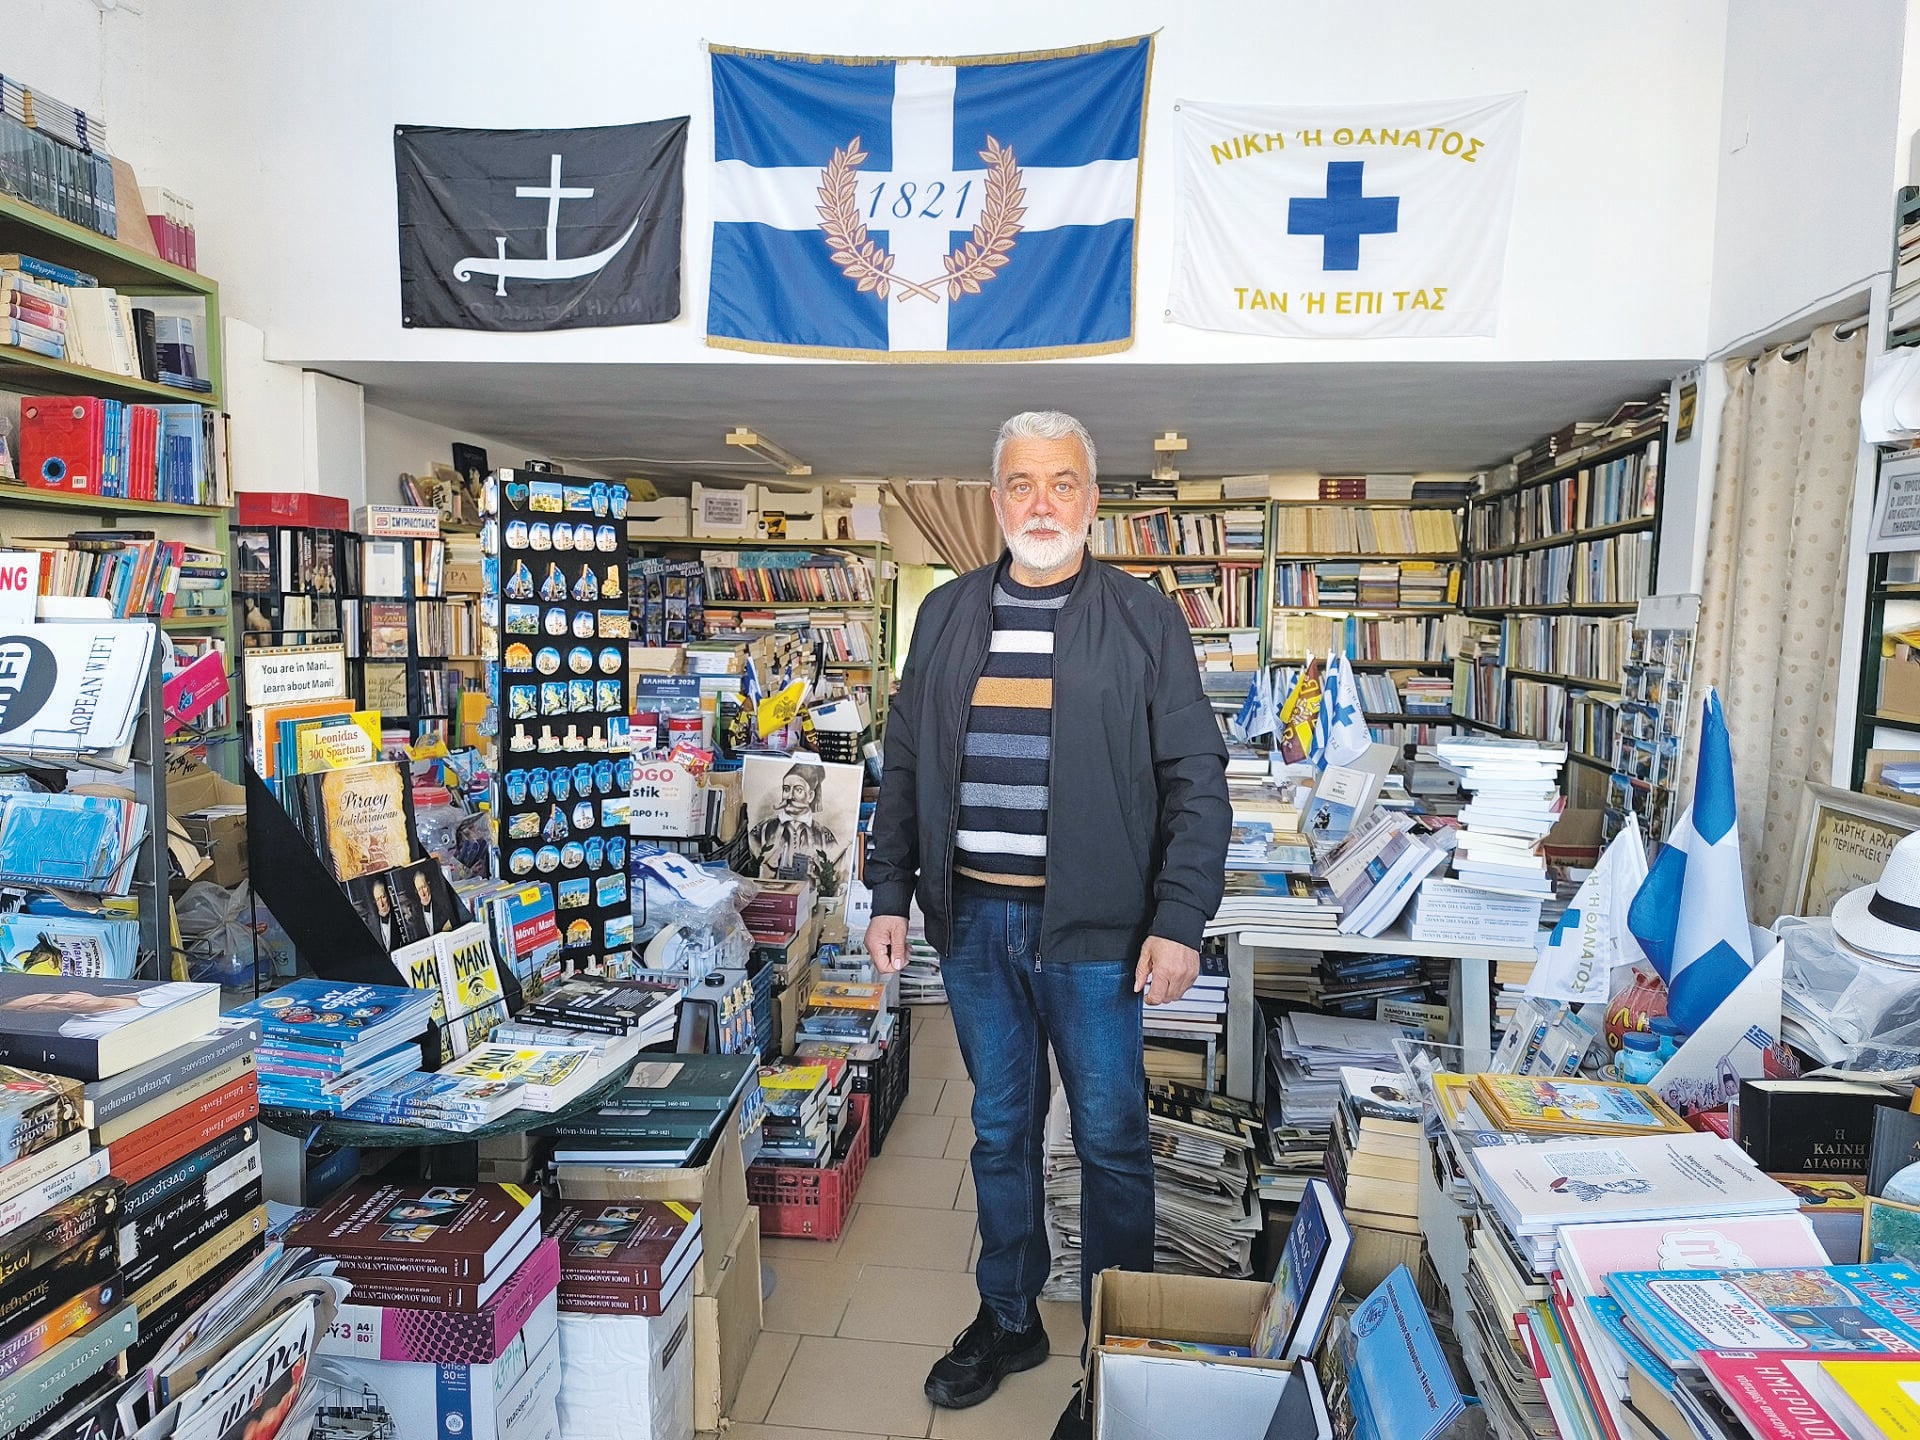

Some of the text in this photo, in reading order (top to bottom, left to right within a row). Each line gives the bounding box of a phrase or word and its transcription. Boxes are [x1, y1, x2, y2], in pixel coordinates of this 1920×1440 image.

[1210, 133, 1285, 165] ΝΙΚΗ
[1333, 127, 1485, 162] ΘΑΝΑΤΟΣ
[869, 180, 972, 218] 1821
[1234, 287, 1288, 313] ΤΑΝ
[1336, 292, 1382, 314] ΕΠΙ
[1392, 287, 1448, 311] ΤΑΣ
[91, 634, 116, 674] WIFI
[261, 663, 278, 675] You
[280, 664, 295, 673] are
[296, 662, 305, 672] in
[263, 675, 335, 693] Learn about Mani!
[315, 729, 359, 746] Leonidas
[308, 744, 366, 761] 300 Spartans
[339, 790, 391, 812] Piracy
[632, 786, 660, 798] stik
[335, 810, 400, 829] Mediterranean
[516, 924, 536, 941] Μάνη
[453, 940, 490, 980] MANI
[1570, 909, 1598, 995] ΘΑΝΑΤΟΣ
[464, 1049, 515, 1076] MANI
[138, 1072, 171, 1097] Δεύτερη
[1835, 1129, 1845, 1140] Η
[1813, 1142, 1865, 1156] ΚΑΙΝΗ
[356, 1323, 370, 1331] A4
[70, 1345, 101, 1368] SCOTT
[39, 1367, 68, 1393] PECK
[443, 1371, 456, 1380] 80
